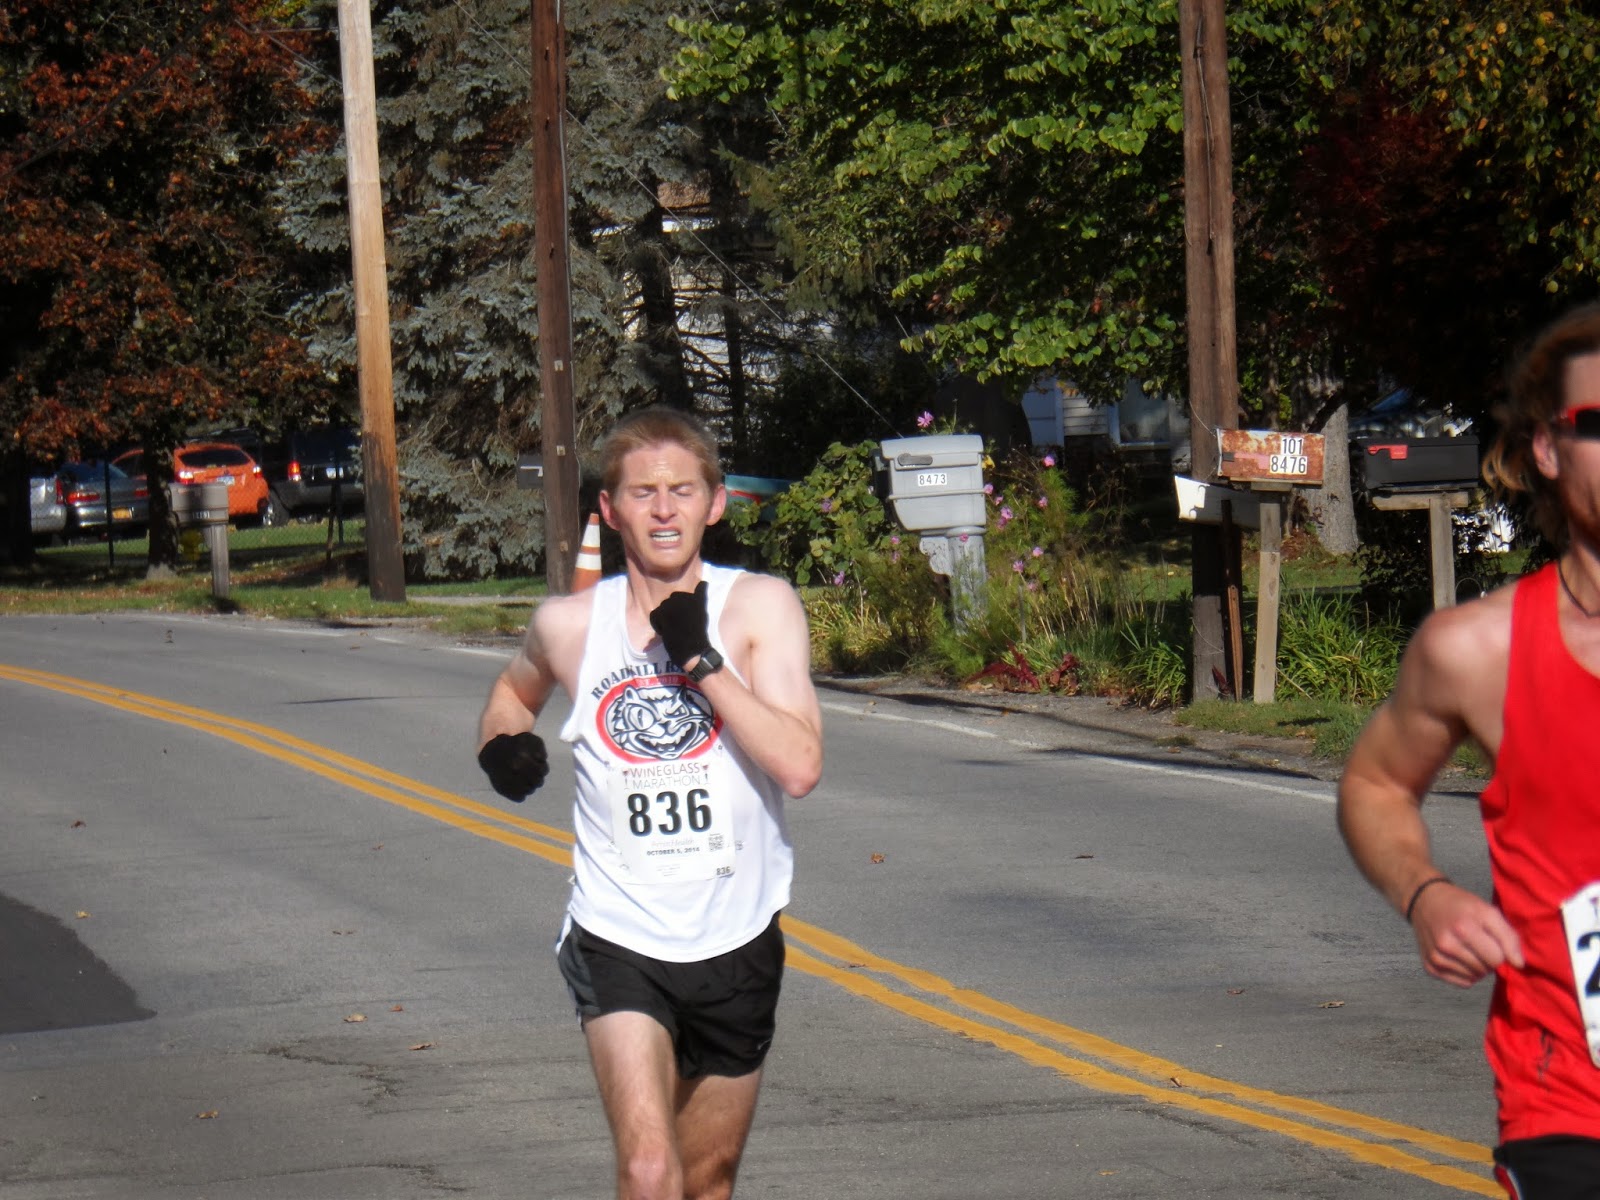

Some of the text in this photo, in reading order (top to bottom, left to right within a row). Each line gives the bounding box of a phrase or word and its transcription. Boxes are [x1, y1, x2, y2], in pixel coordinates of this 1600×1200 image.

[1282, 438, 1303, 454] 101
[1271, 456, 1307, 473] 8476
[919, 474, 946, 485] 8473
[591, 663, 662, 701] ROADKILL
[630, 762, 700, 778] WINEGLASS
[632, 775, 701, 790] MARATHON
[627, 788, 712, 837] 836
[716, 866, 731, 875] 836
